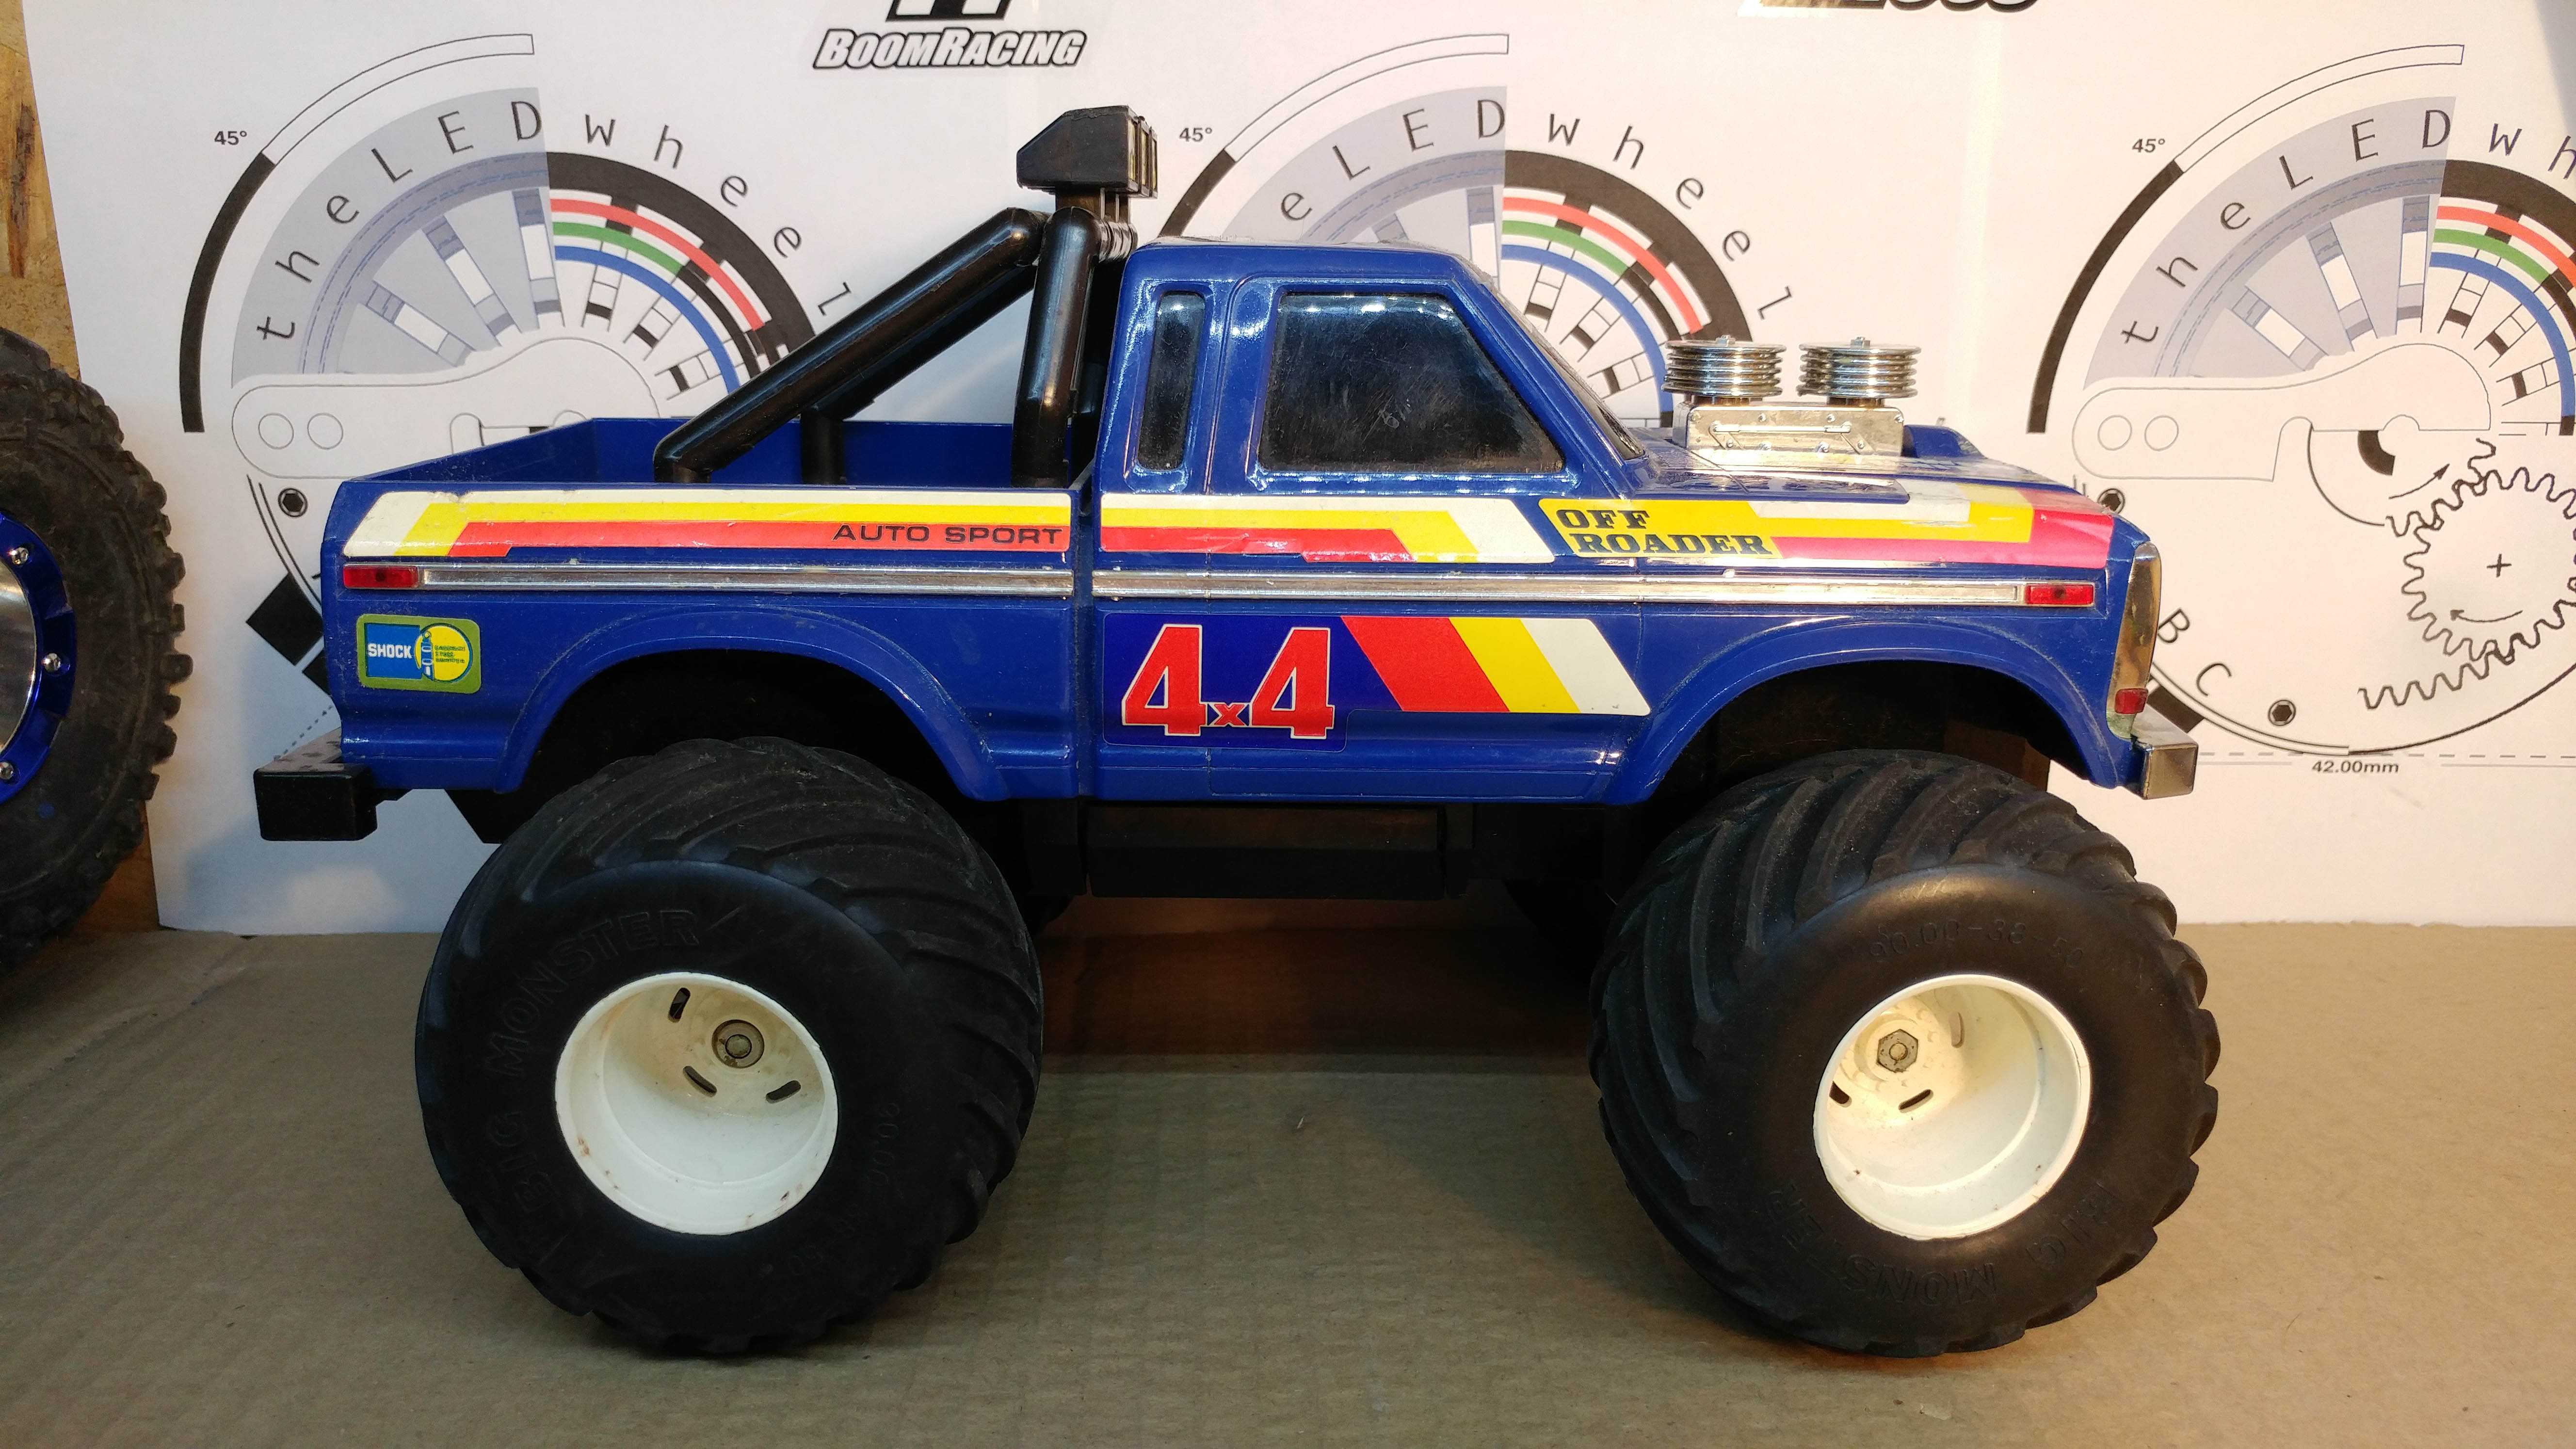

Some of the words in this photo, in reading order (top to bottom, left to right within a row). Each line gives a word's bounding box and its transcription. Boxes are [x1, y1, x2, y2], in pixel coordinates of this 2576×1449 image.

[214, 130, 247, 145] 45°
[1179, 127, 1212, 142] 45°
[2132, 138, 2165, 153] 45°
[1556, 509, 1650, 529] OFF
[832, 524, 930, 542] AUTO
[945, 526, 1063, 545] SPORT
[1569, 533, 1772, 555] ROADER
[367, 643, 413, 659] SHOCK
[1122, 624, 1335, 739] 4x4
[2312, 760, 2399, 773] 42.00mm
